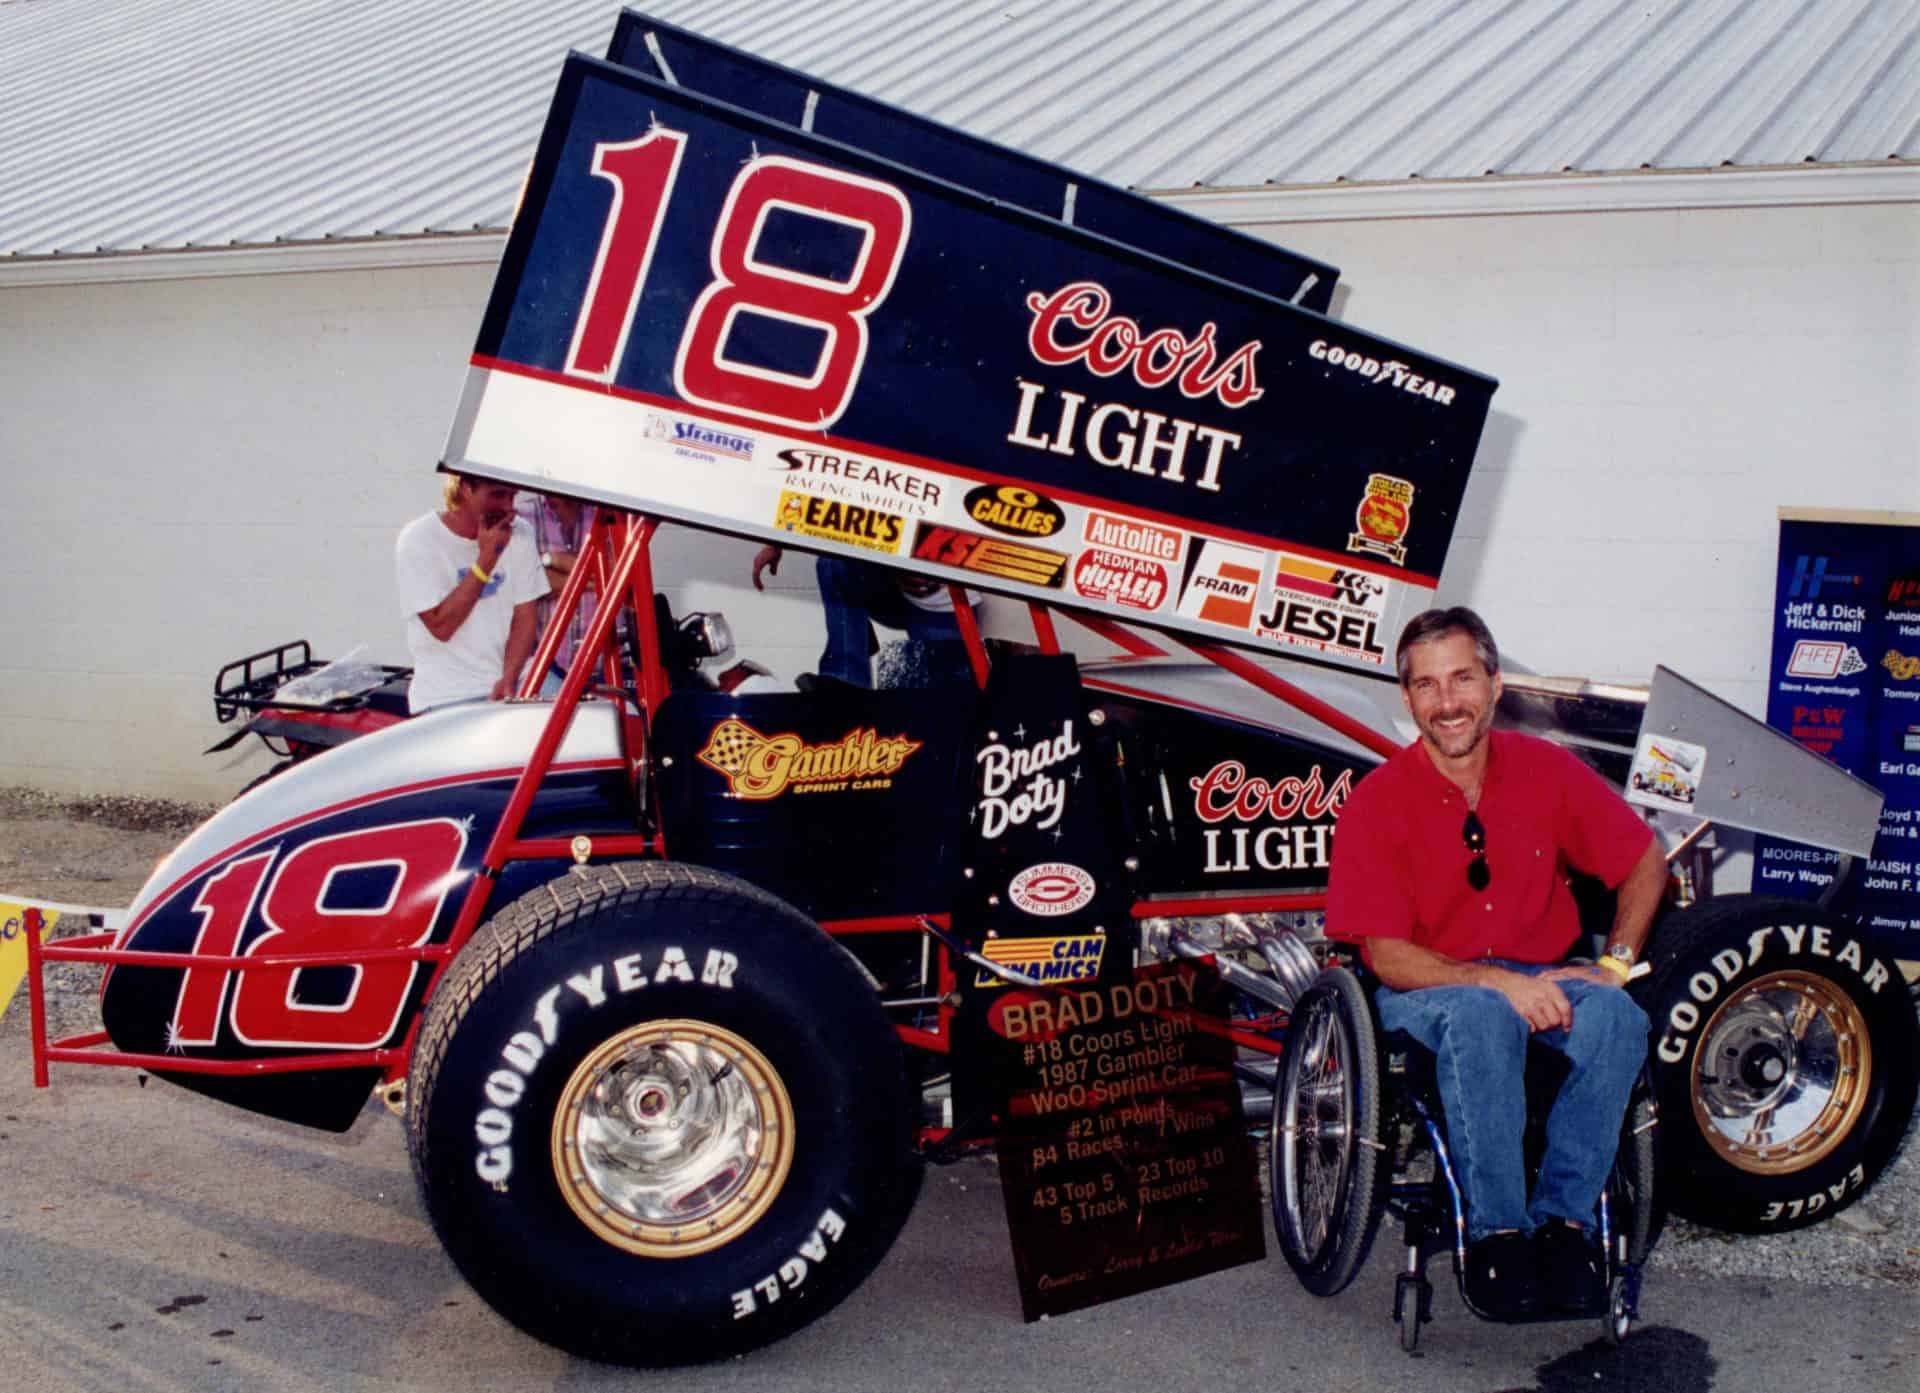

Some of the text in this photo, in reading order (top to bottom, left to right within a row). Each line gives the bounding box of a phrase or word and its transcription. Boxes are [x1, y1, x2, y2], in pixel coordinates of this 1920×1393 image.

[563, 127, 912, 432] 18
[1027, 281, 1265, 409] Coors
[1308, 339, 1456, 406] GOODYEAR
[674, 421, 755, 453] Strange
[1007, 380, 1241, 491] LIGHT
[777, 449, 941, 506] STREAKER
[785, 473, 852, 498] RACING
[805, 496, 903, 543] EARL'S
[972, 498, 1058, 536] CALLIES
[1089, 516, 1176, 559] Autolite
[1093, 551, 1158, 577] HEDMAN
[1194, 575, 1249, 598] FRAM
[1329, 569, 1383, 606] K&N
[1259, 600, 1385, 655] JESEL
[1784, 602, 1867, 620] Jeff & Dick
[1785, 615, 1862, 632] Hickernell
[732, 728, 922, 799] Gambler
[977, 720, 1080, 797] Brad
[1880, 761, 1904, 775] Earl
[793, 778, 892, 795] SPRINT CARS
[979, 773, 1065, 839] Doty
[1878, 808, 1911, 822] loyd
[1908, 826, 1918, 838] &
[1203, 824, 1336, 873] LIGH
[1865, 859, 1911, 875] MAISH
[1762, 866, 1835, 886] Larry Wagn
[1864, 877, 1898, 890] John
[173, 817, 469, 1051] 18
[1871, 916, 1908, 930] Jimmy
[1053, 938, 1103, 959] CAM
[1002, 973, 1199, 1040] BRAD DOTY
[1657, 924, 1890, 1064] GOODYEAR
[1024, 1014, 1195, 1065] #18 Coors Light
[475, 946, 740, 1184] GOODYEAR
[1039, 1041, 1186, 1089] 1987 Gambler
[1092, 1071, 1158, 1105] Sprint
[1162, 1063, 1200, 1087] Car
[1066, 1134, 1123, 1161] Races
[1071, 1117, 1095, 1138] #2
[1100, 1114, 1116, 1134] in
[1033, 1185, 1057, 1209] 43
[1063, 1180, 1097, 1204] Top
[1102, 1172, 1115, 1192] 5
[1138, 1161, 1161, 1184] 23
[1165, 1155, 1198, 1178] Top
[1058, 1177, 1210, 1225] 5 Track Records
[1760, 1162, 1866, 1222] EAGLE
[731, 1207, 848, 1321] EAGLE
